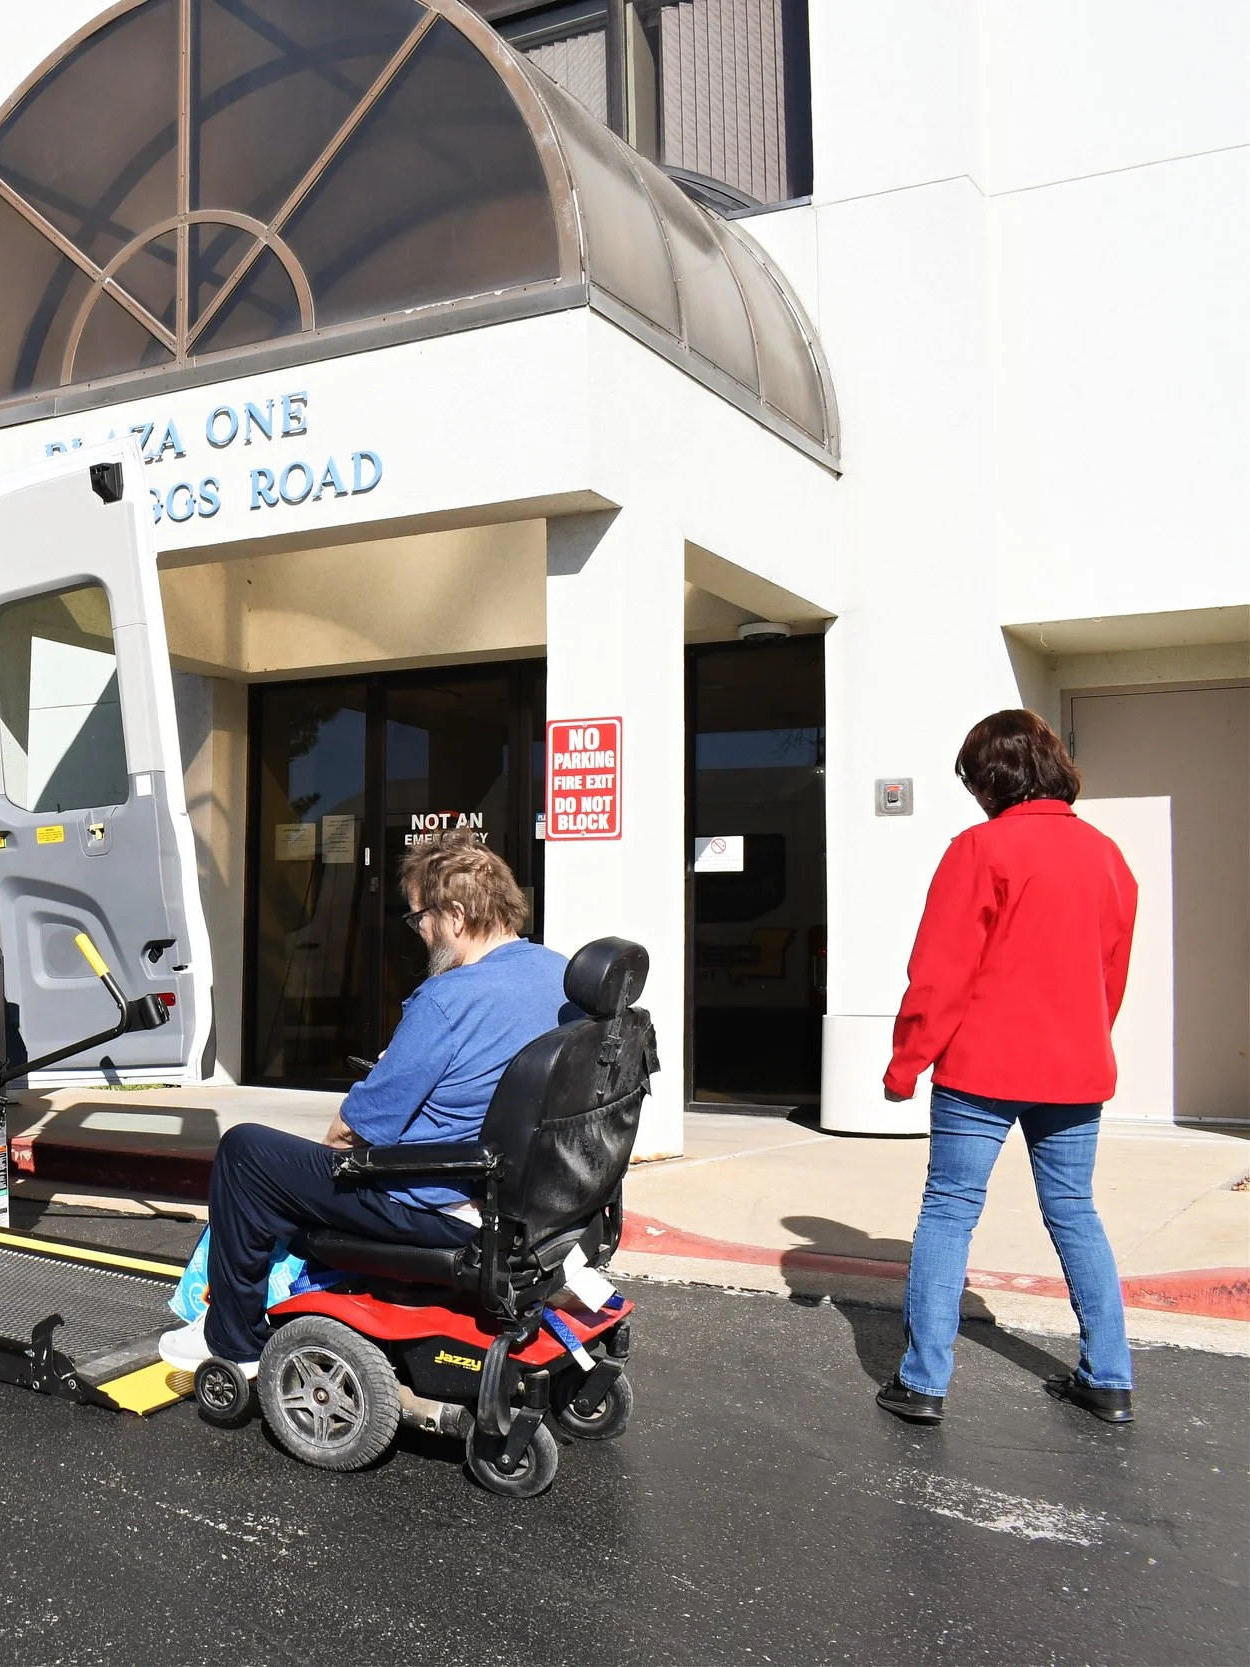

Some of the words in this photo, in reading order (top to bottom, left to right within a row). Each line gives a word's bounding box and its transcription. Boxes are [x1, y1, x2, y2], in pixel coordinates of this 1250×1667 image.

[206, 391, 308, 446] ONE
[250, 451, 383, 509] ROAD
[568, 728, 600, 750] NO
[554, 750, 614, 770] PARKING
[554, 775, 582, 790] FIRE
[586, 774, 614, 789] EXIT
[554, 797, 576, 813] DO
[581, 795, 613, 812] NOT
[411, 813, 450, 830] NOT
[456, 812, 483, 829] AN
[557, 813, 610, 830] BLOCK
[434, 1350, 482, 1371] Jazzy
